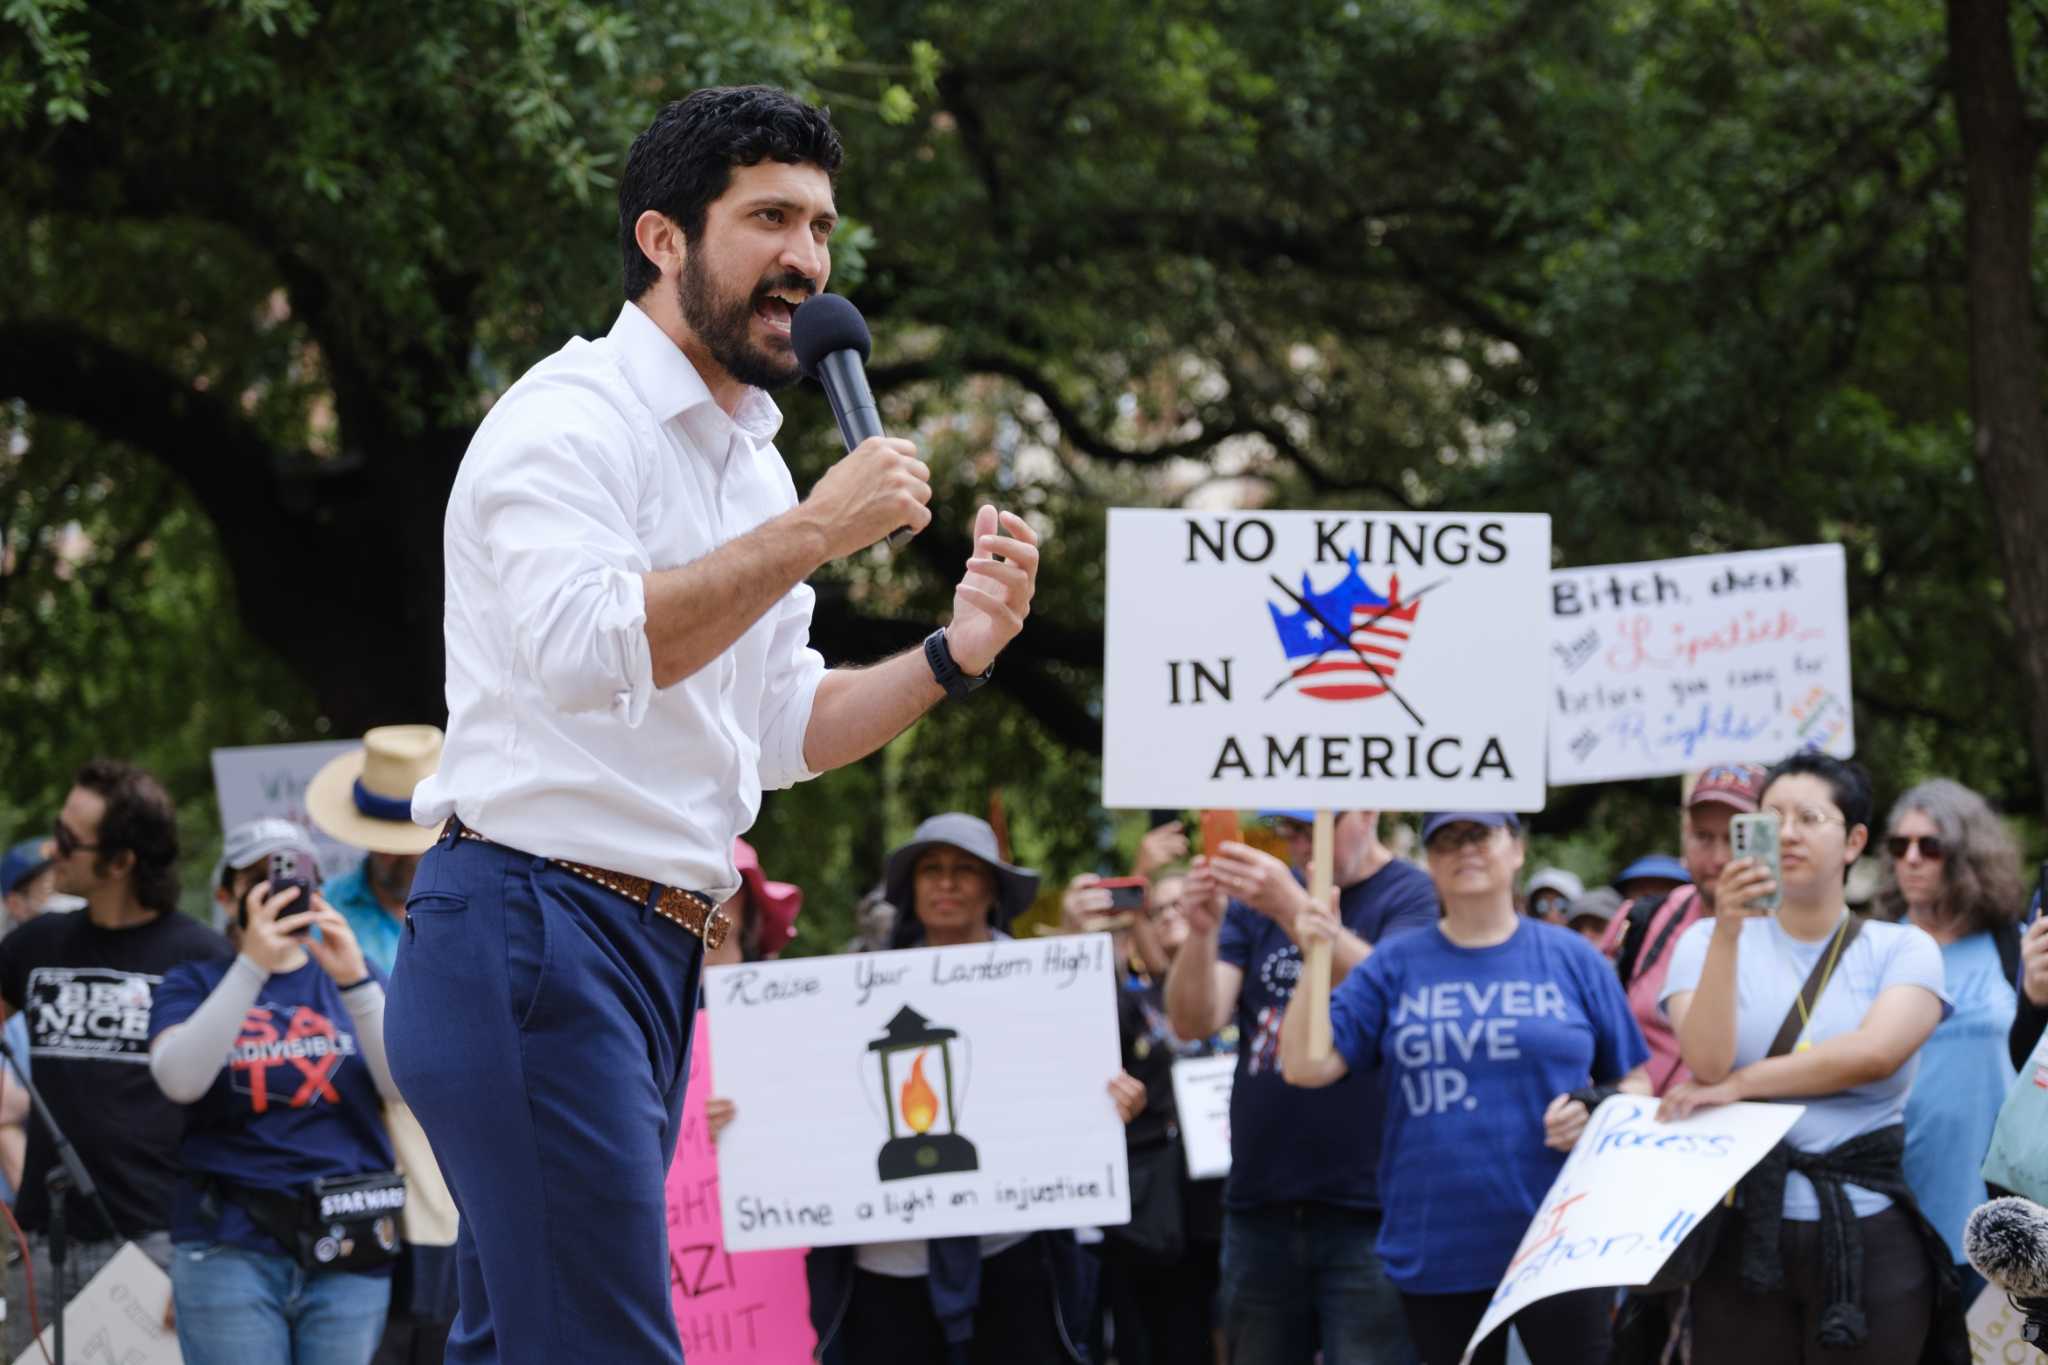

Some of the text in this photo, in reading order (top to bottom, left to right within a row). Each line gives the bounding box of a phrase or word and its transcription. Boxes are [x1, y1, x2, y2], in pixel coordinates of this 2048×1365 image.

[1186, 519, 1509, 566] NO KINGS
[1167, 658, 1232, 705] IN
[1211, 735, 1514, 780] AMERICA
[1043, 940, 1104, 989] High!
[36, 1003, 151, 1040] NICE
[1395, 981, 1568, 1025] NEVER
[1395, 1020, 1521, 1067] GIVE
[231, 1051, 342, 1115] TX
[1402, 1068, 1477, 1116] UP.
[321, 1191, 366, 1216] STAR
[735, 1164, 1116, 1232] Shine a light on injustice!
[669, 1243, 736, 1299] AZI
